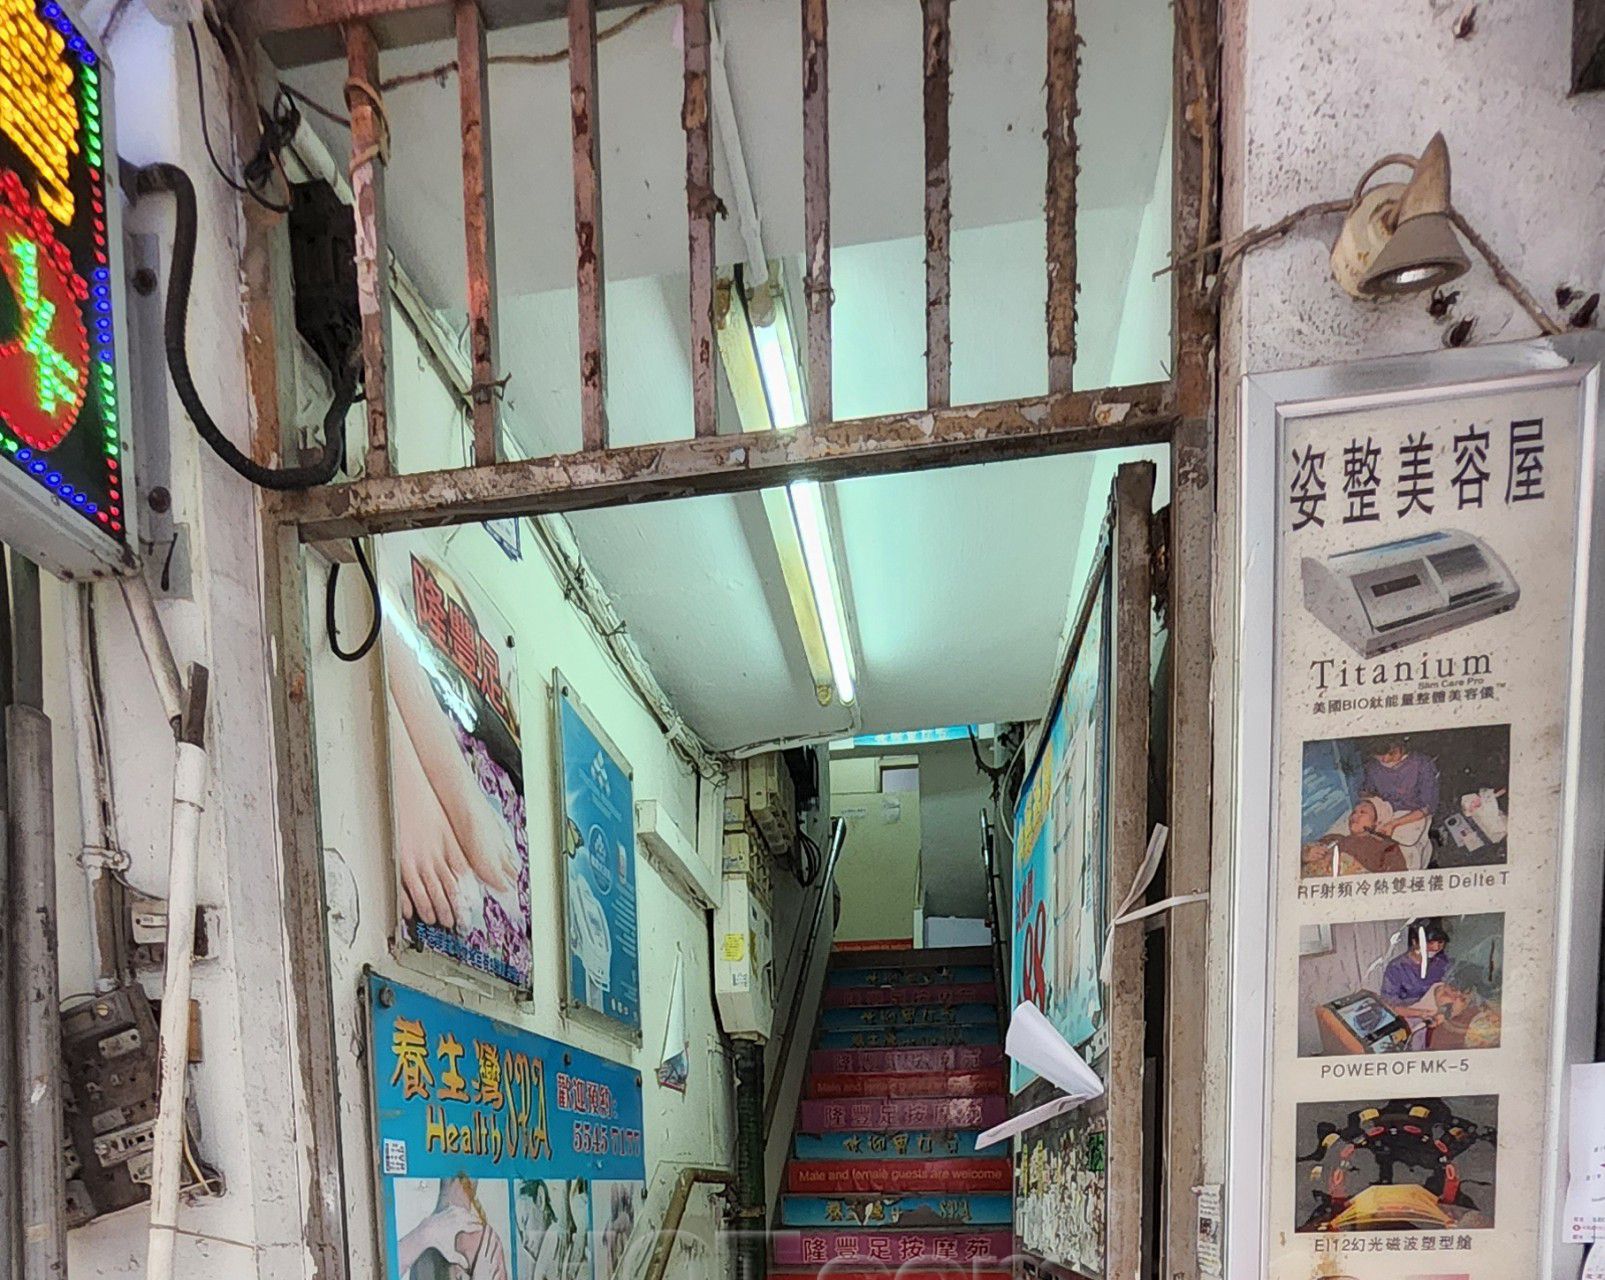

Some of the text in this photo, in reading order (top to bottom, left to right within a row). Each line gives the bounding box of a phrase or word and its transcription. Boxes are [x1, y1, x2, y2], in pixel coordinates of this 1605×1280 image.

[1290, 418, 1544, 530] 姿整美容屋
[1310, 651, 1492, 690] Titanium
[1321, 1059, 1469, 1079] POWER OF MK-5
[799, 1171, 822, 1181] Male
[828, 1170, 848, 1180] and
[931, 1170, 949, 1179] are
[803, 1236, 993, 1262] 隆豐足按摩苑
